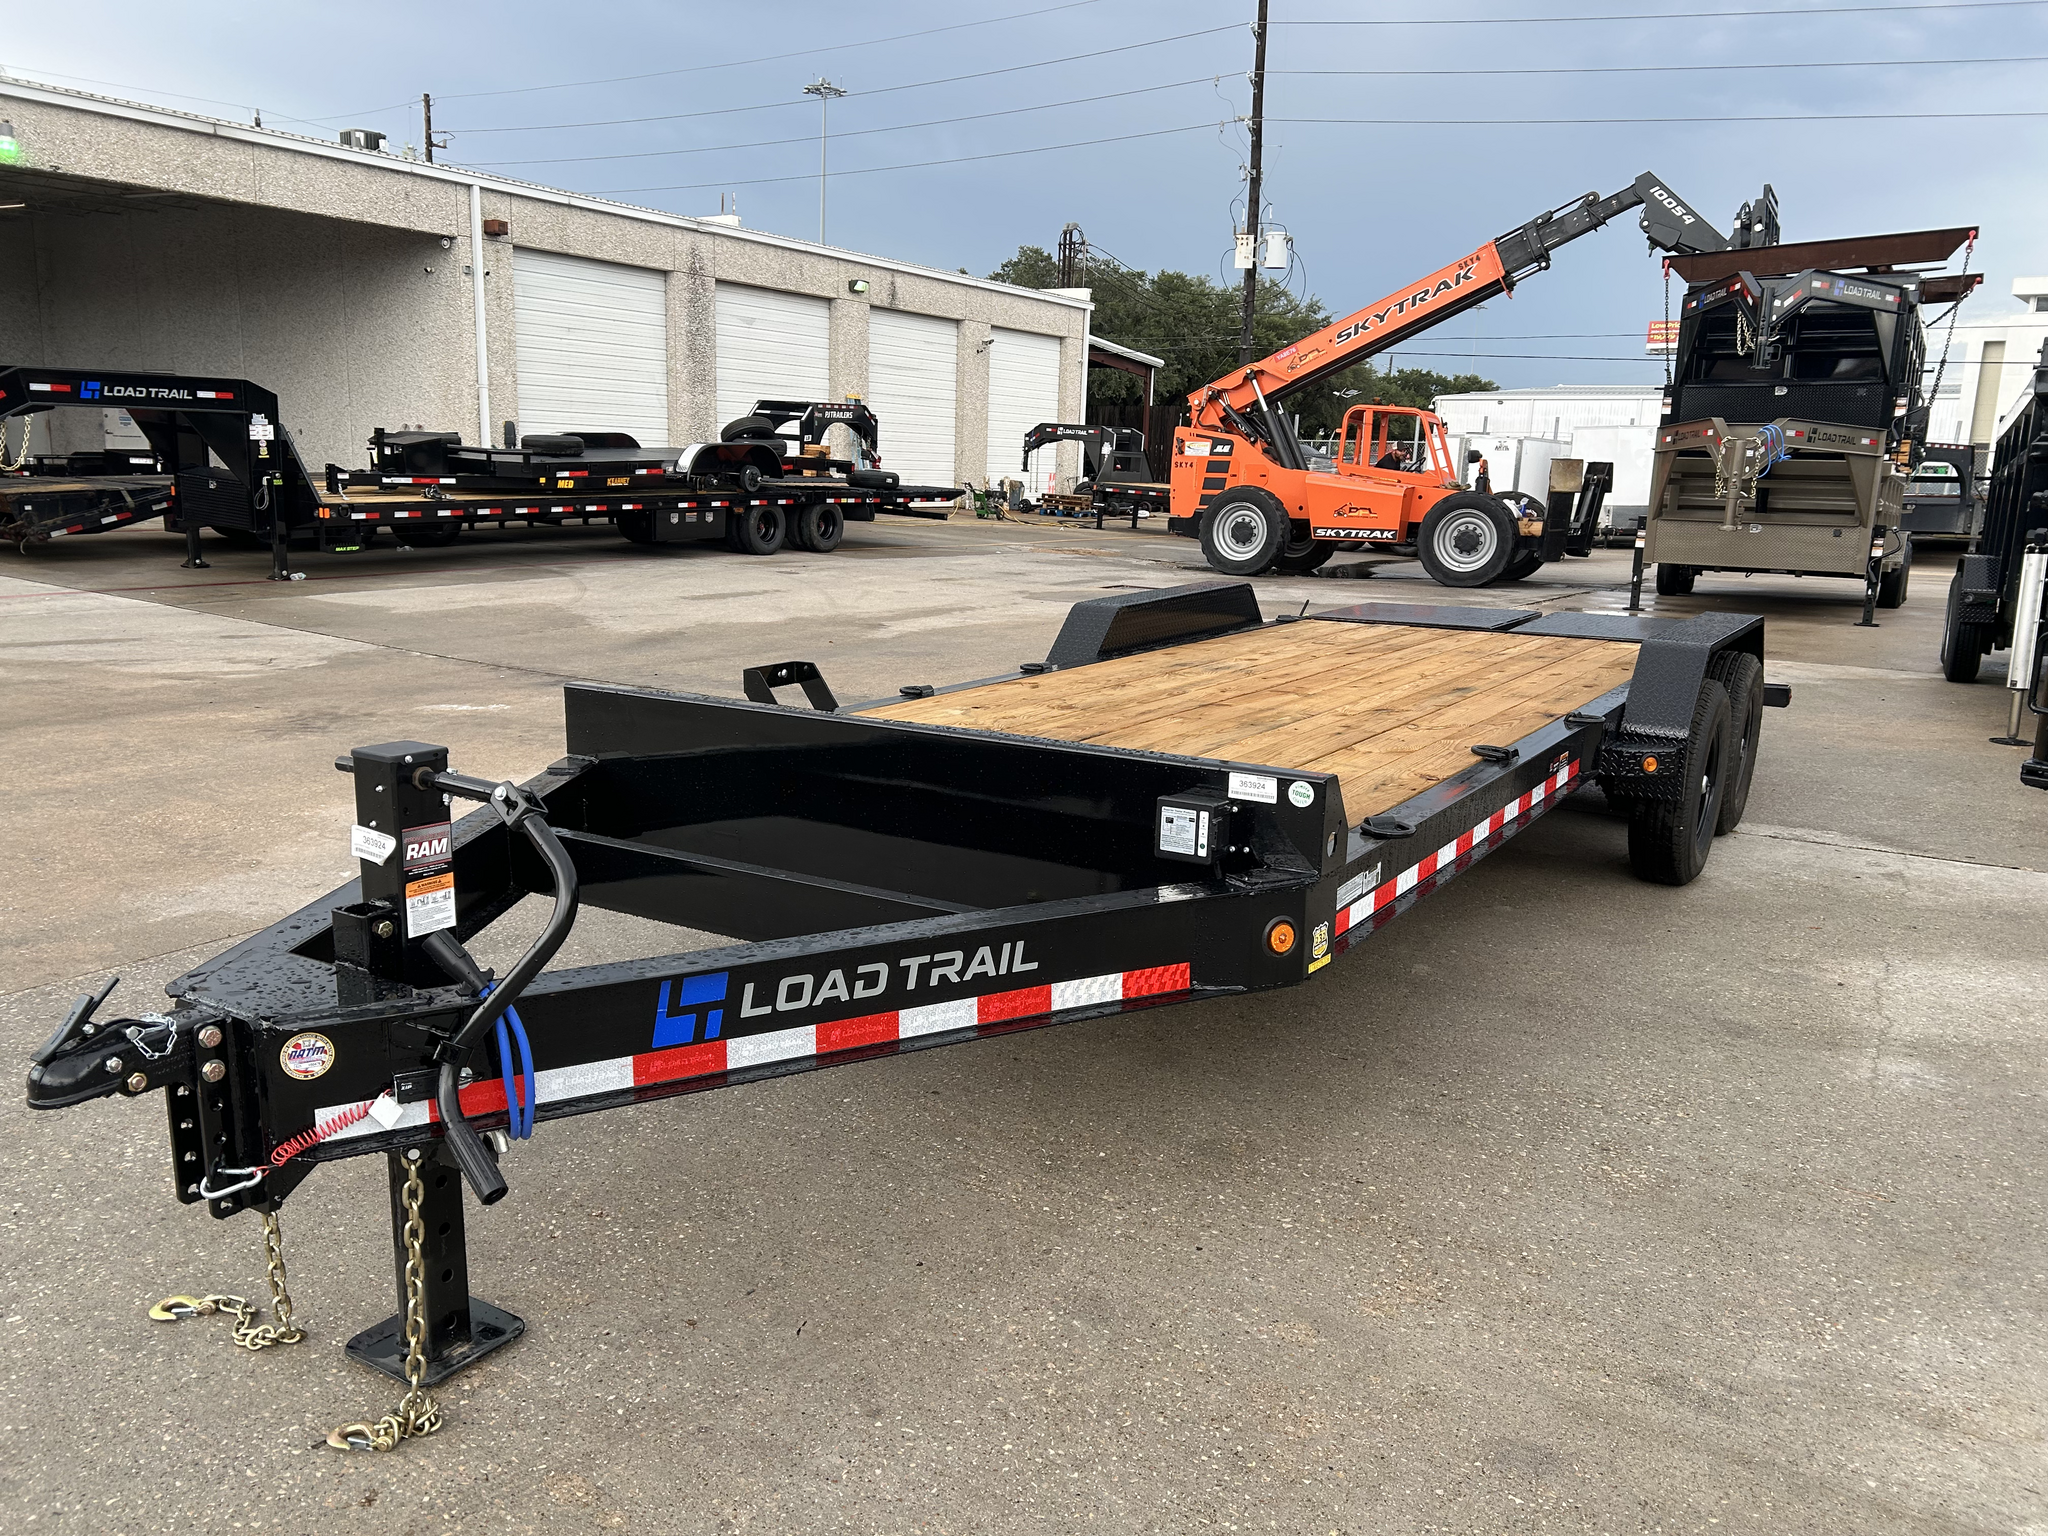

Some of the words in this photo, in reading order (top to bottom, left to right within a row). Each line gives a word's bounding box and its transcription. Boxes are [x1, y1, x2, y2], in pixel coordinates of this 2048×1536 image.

[1649, 186, 1696, 224] 10054
[1458, 254, 1481, 270] SKY4
[1844, 284, 1862, 297] LOAD
[1861, 289, 1881, 300] TRAIL
[1335, 263, 1478, 346] SKYTRAK
[104, 386, 147, 397] LOAD
[149, 388, 193, 399] TRAIL
[1818, 433, 1837, 443] LOAD
[1836, 435, 1856, 445] TRAIL
[1213, 445, 1232, 453] JLG
[1315, 528, 1396, 538] SKYTRAK
[1239, 780, 1266, 790] 363924
[1292, 789, 1311, 800] TOUGH
[362, 835, 386, 850] 363924
[406, 837, 449, 860] RAM
[740, 962, 889, 1018] LOAD
[900, 940, 1039, 991] TRAIL
[288, 1045, 326, 1060] NATM
